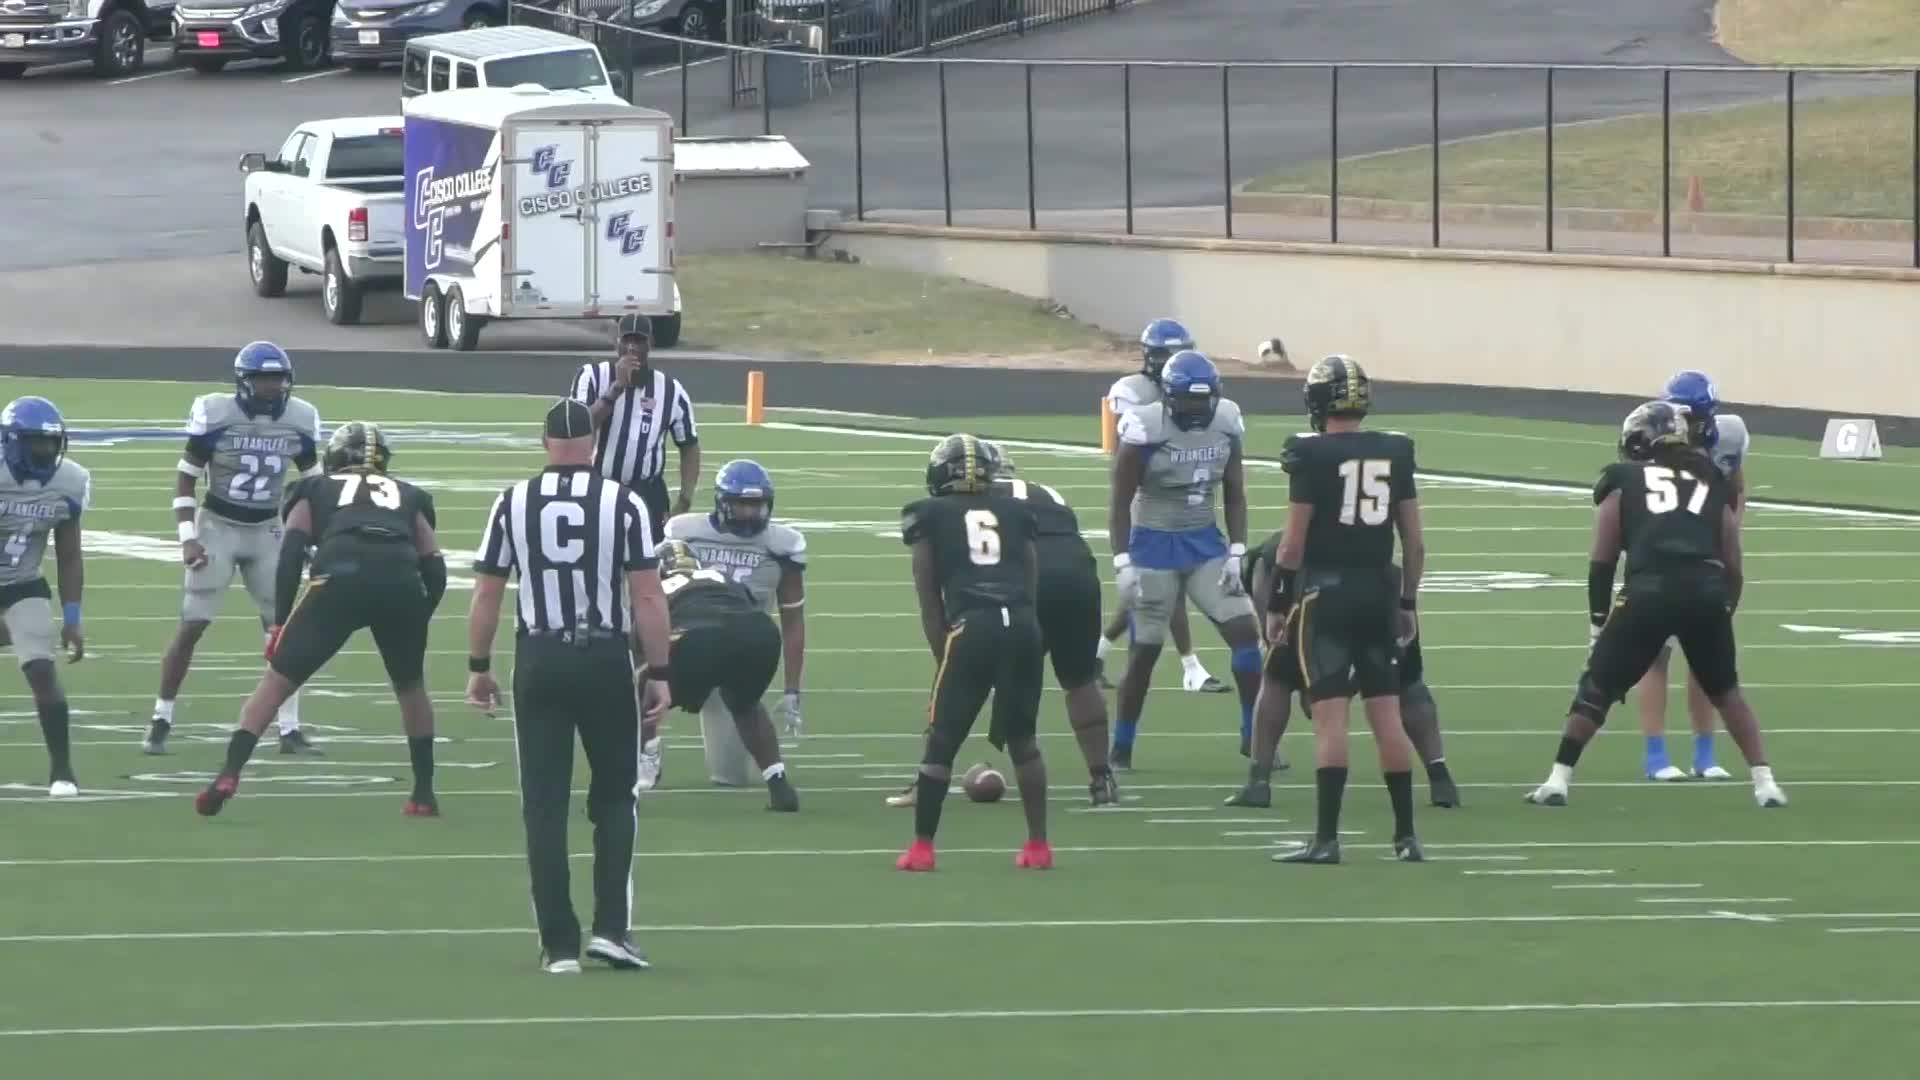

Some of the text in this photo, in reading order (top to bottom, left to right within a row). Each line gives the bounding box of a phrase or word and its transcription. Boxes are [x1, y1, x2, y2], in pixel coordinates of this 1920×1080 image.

[519, 190, 572, 216] CISCO
[574, 174, 653, 205] COLLEGE
[233, 436, 290, 452] WRANGLERS
[1169, 446, 1227, 463] WRANGLERS
[1836, 423, 1859, 453] G
[228, 454, 282, 500] 22
[328, 473, 401, 510] 73
[1338, 458, 1391, 525] 15
[1643, 465, 1710, 515] 57
[4, 522, 34, 567] 4
[540, 501, 585, 564] C
[964, 509, 1001, 566] 6
[701, 548, 760, 568] WRANGLERS
